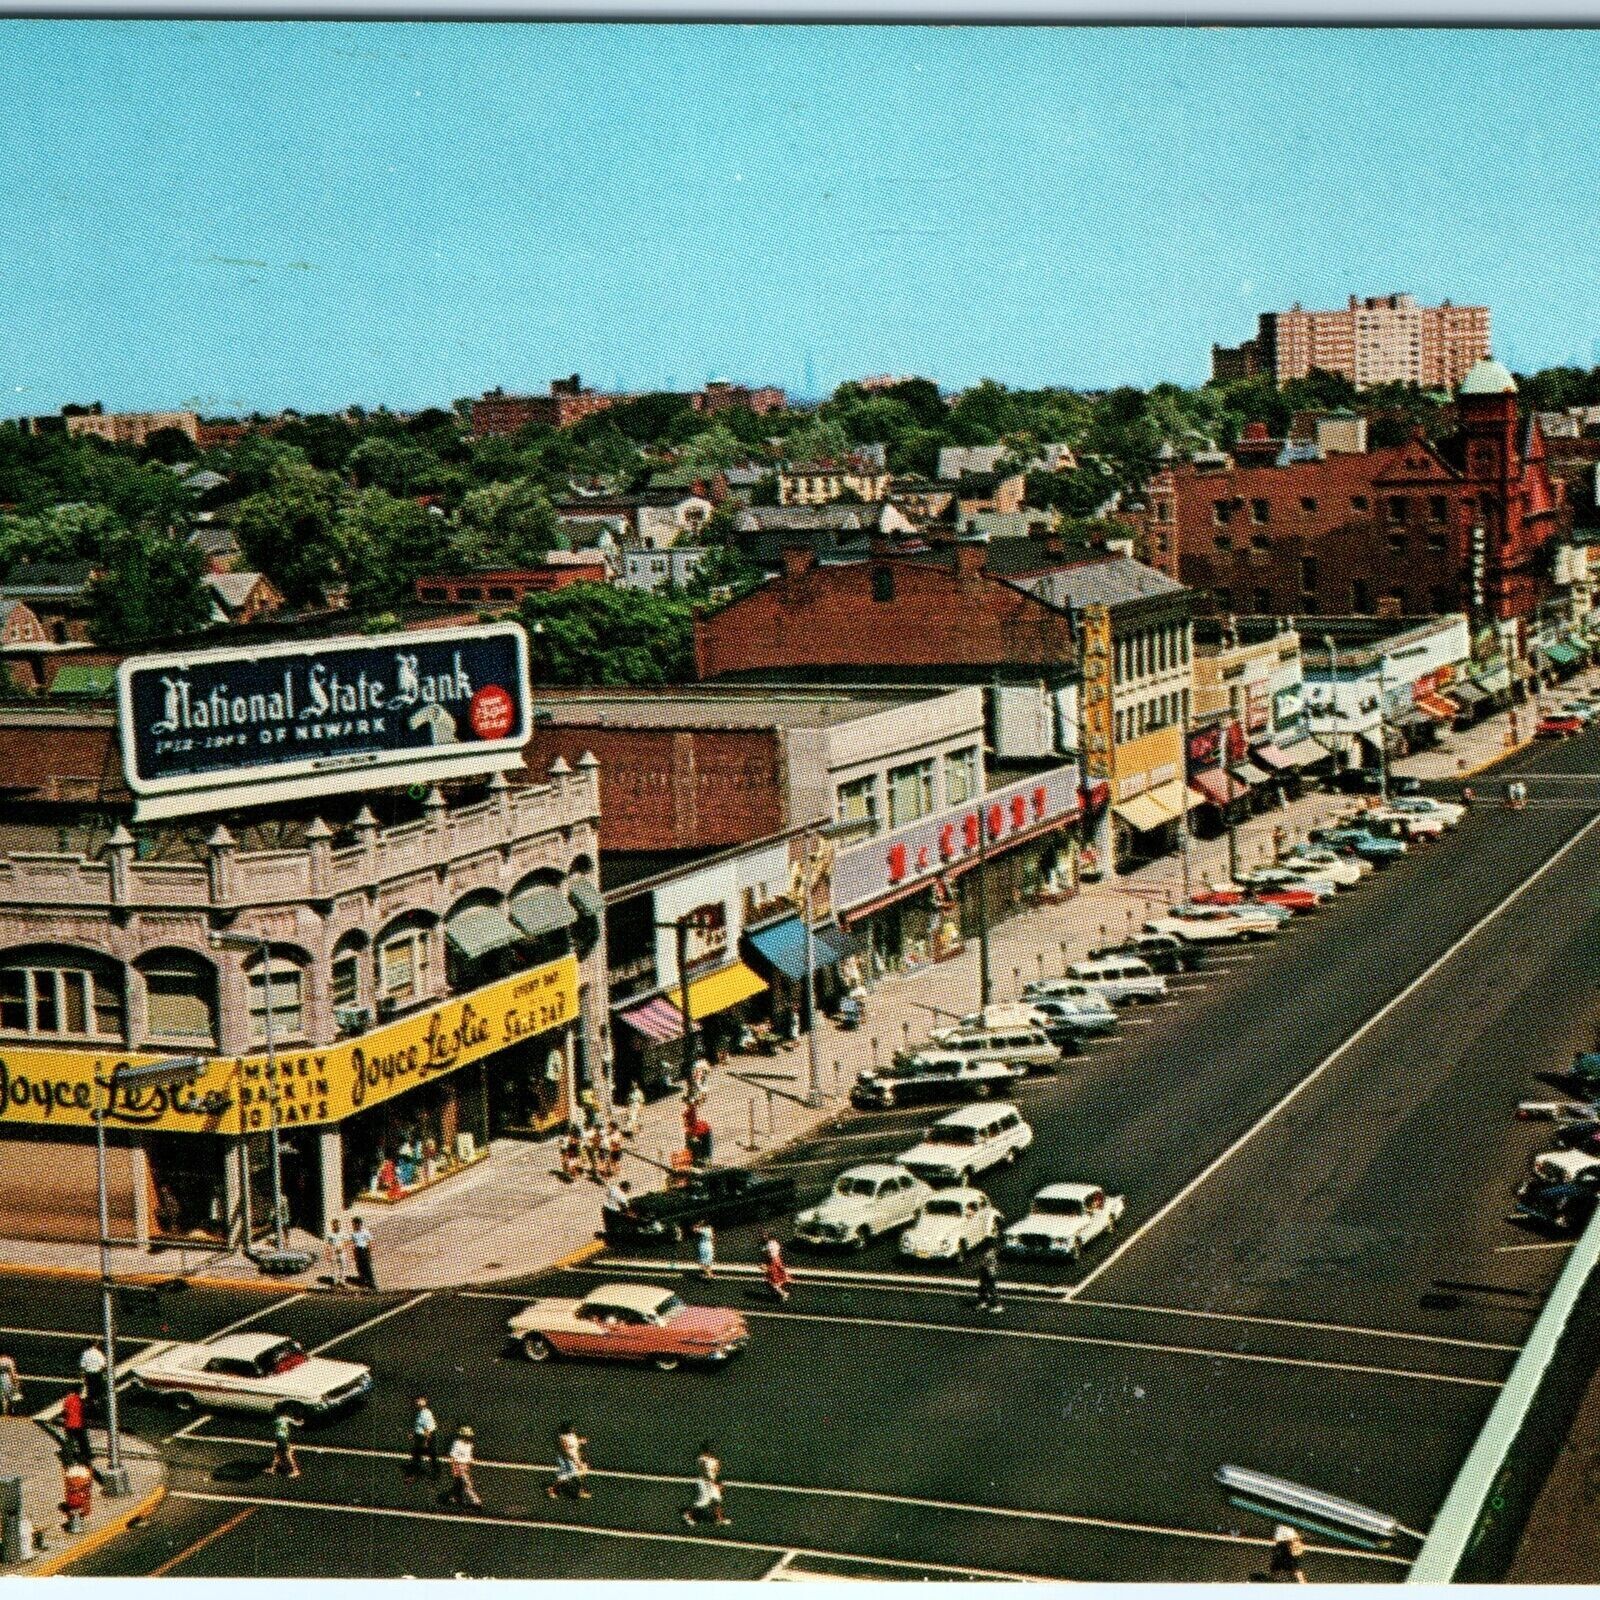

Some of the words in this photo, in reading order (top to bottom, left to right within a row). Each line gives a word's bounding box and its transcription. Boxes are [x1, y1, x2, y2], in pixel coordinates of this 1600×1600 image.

[151, 671, 294, 735] National
[299, 662, 386, 721] State
[385, 650, 475, 711] Bank
[258, 726, 287, 744] OF
[295, 716, 385, 740] NEWARK
[244, 1056, 326, 1080] MONEY
[351, 1046, 418, 1107] Joyce
[418, 1002, 489, 1078] Leslie
[306, 1079, 328, 1097] IN
